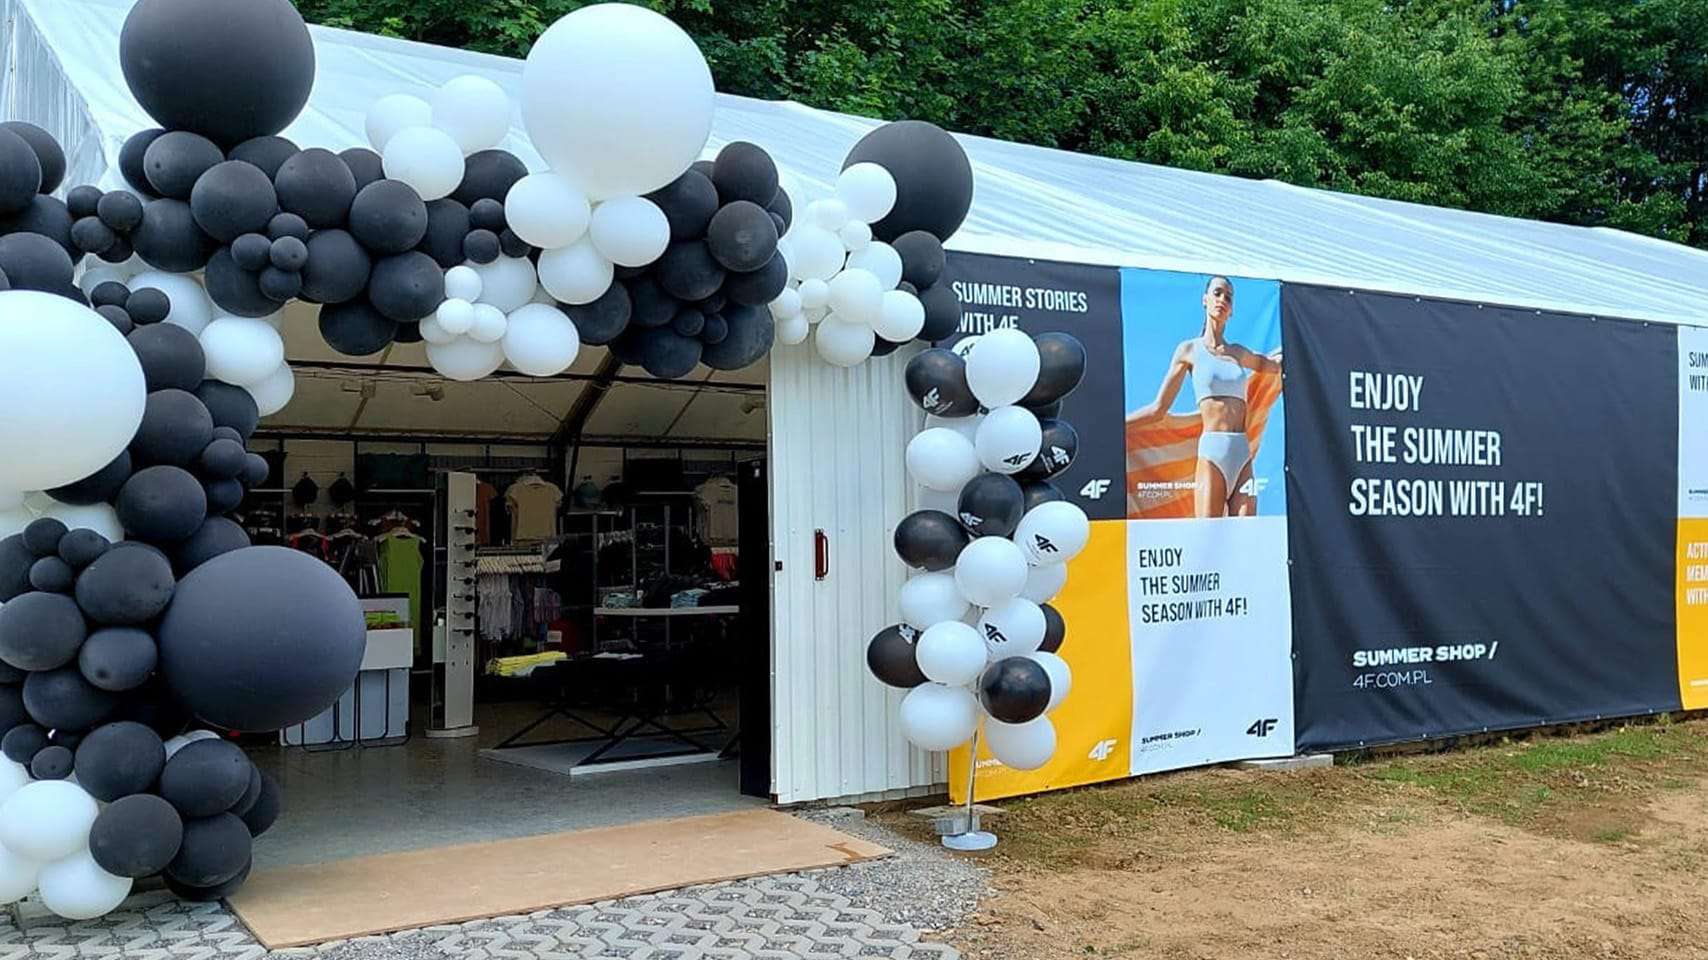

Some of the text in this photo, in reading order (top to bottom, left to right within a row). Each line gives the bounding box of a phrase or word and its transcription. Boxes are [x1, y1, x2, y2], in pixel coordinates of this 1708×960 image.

[952, 281, 1088, 312] SUMMER STORIES
[1350, 371, 1423, 411] ENJOY
[1350, 425, 1501, 466] THE SUMMER
[1080, 479, 1111, 499] 4F
[1349, 478, 1544, 516] SEASON WITH 4F!
[1139, 548, 1182, 568] ENJOY
[1140, 572, 1220, 595] THE SUMMER
[1142, 597, 1247, 623] SEASON WITH 4F!
[1353, 647, 1433, 667] SUMMER
[1435, 644, 1486, 661] SHOP
[1353, 670, 1432, 688] 4F.COM.PL
[1246, 719, 1278, 737] 4F
[1088, 739, 1117, 760] 4F
